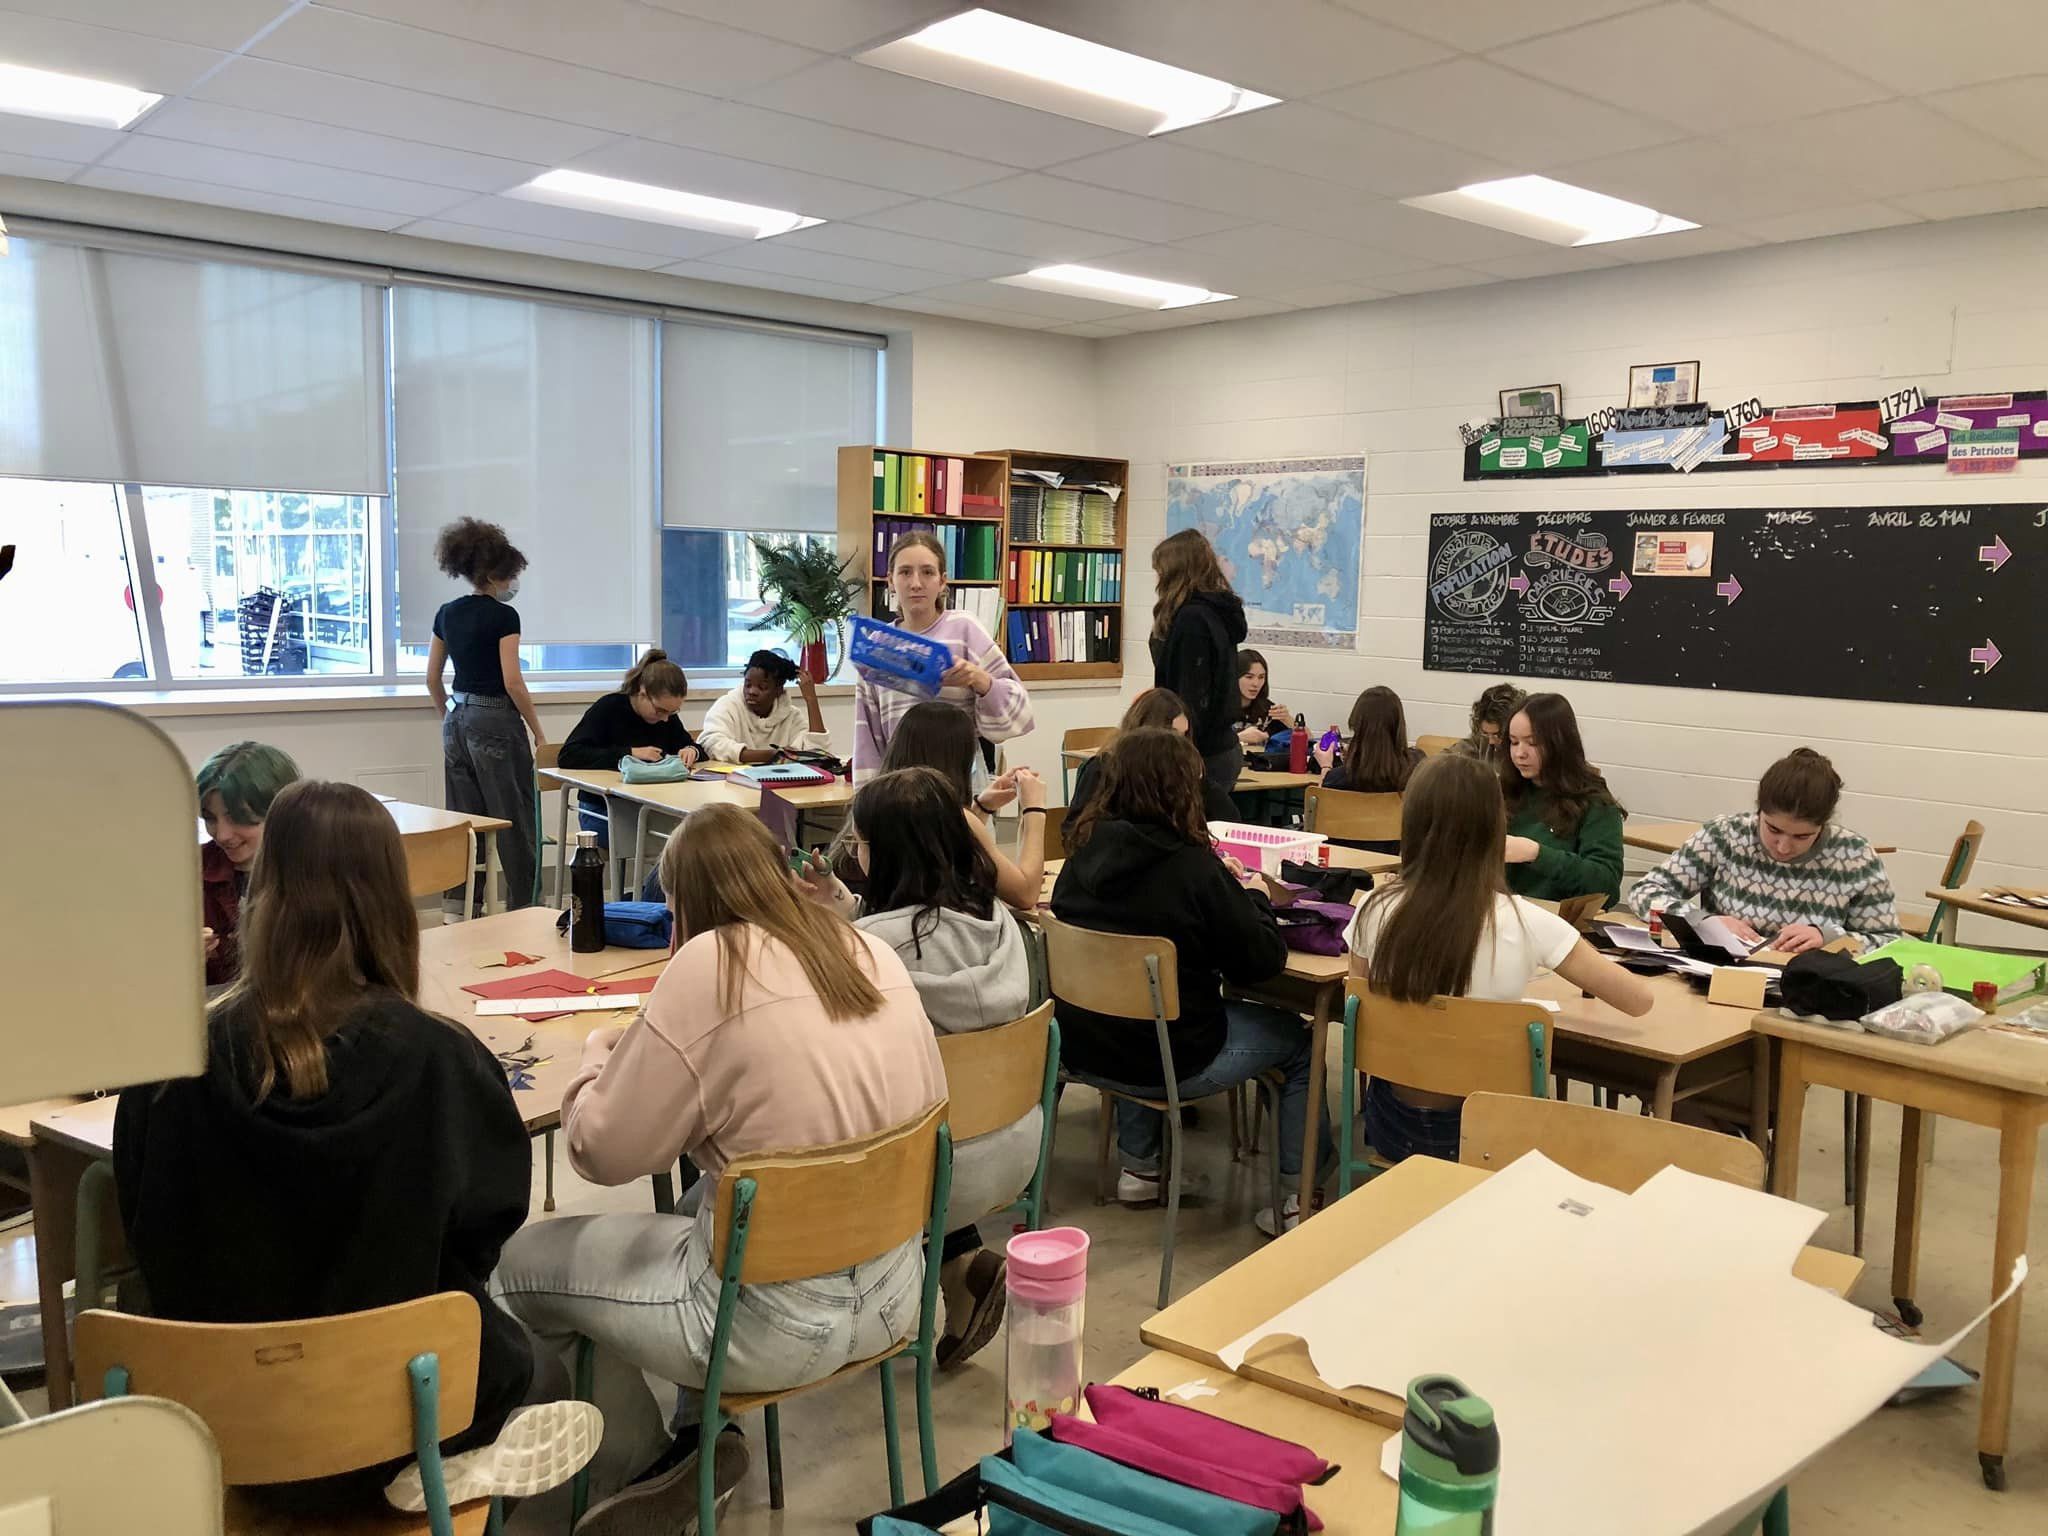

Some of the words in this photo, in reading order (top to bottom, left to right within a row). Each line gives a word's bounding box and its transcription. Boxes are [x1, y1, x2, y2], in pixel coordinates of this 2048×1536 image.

[1881, 387, 1924, 421] 1791
[1586, 406, 1616, 435] 1608
[1725, 398, 1761, 431] 1760
[1952, 447, 1967, 456] des
[1970, 446, 2015, 456] Patriotes
[1432, 513, 1467, 527] OCTOBRE
[1471, 514, 1479, 525] &
[1480, 512, 1520, 526] NOVEMBRE
[1626, 512, 1666, 527] JANVIER
[1669, 515, 1680, 526] &
[1682, 510, 1726, 526] FÉVRIER
[1764, 510, 1815, 525] MARS
[1868, 511, 1912, 527] AVRIL
[1919, 511, 1938, 527] &
[1938, 510, 1971, 526] MAI
[1431, 542, 1514, 604] POPULATION
